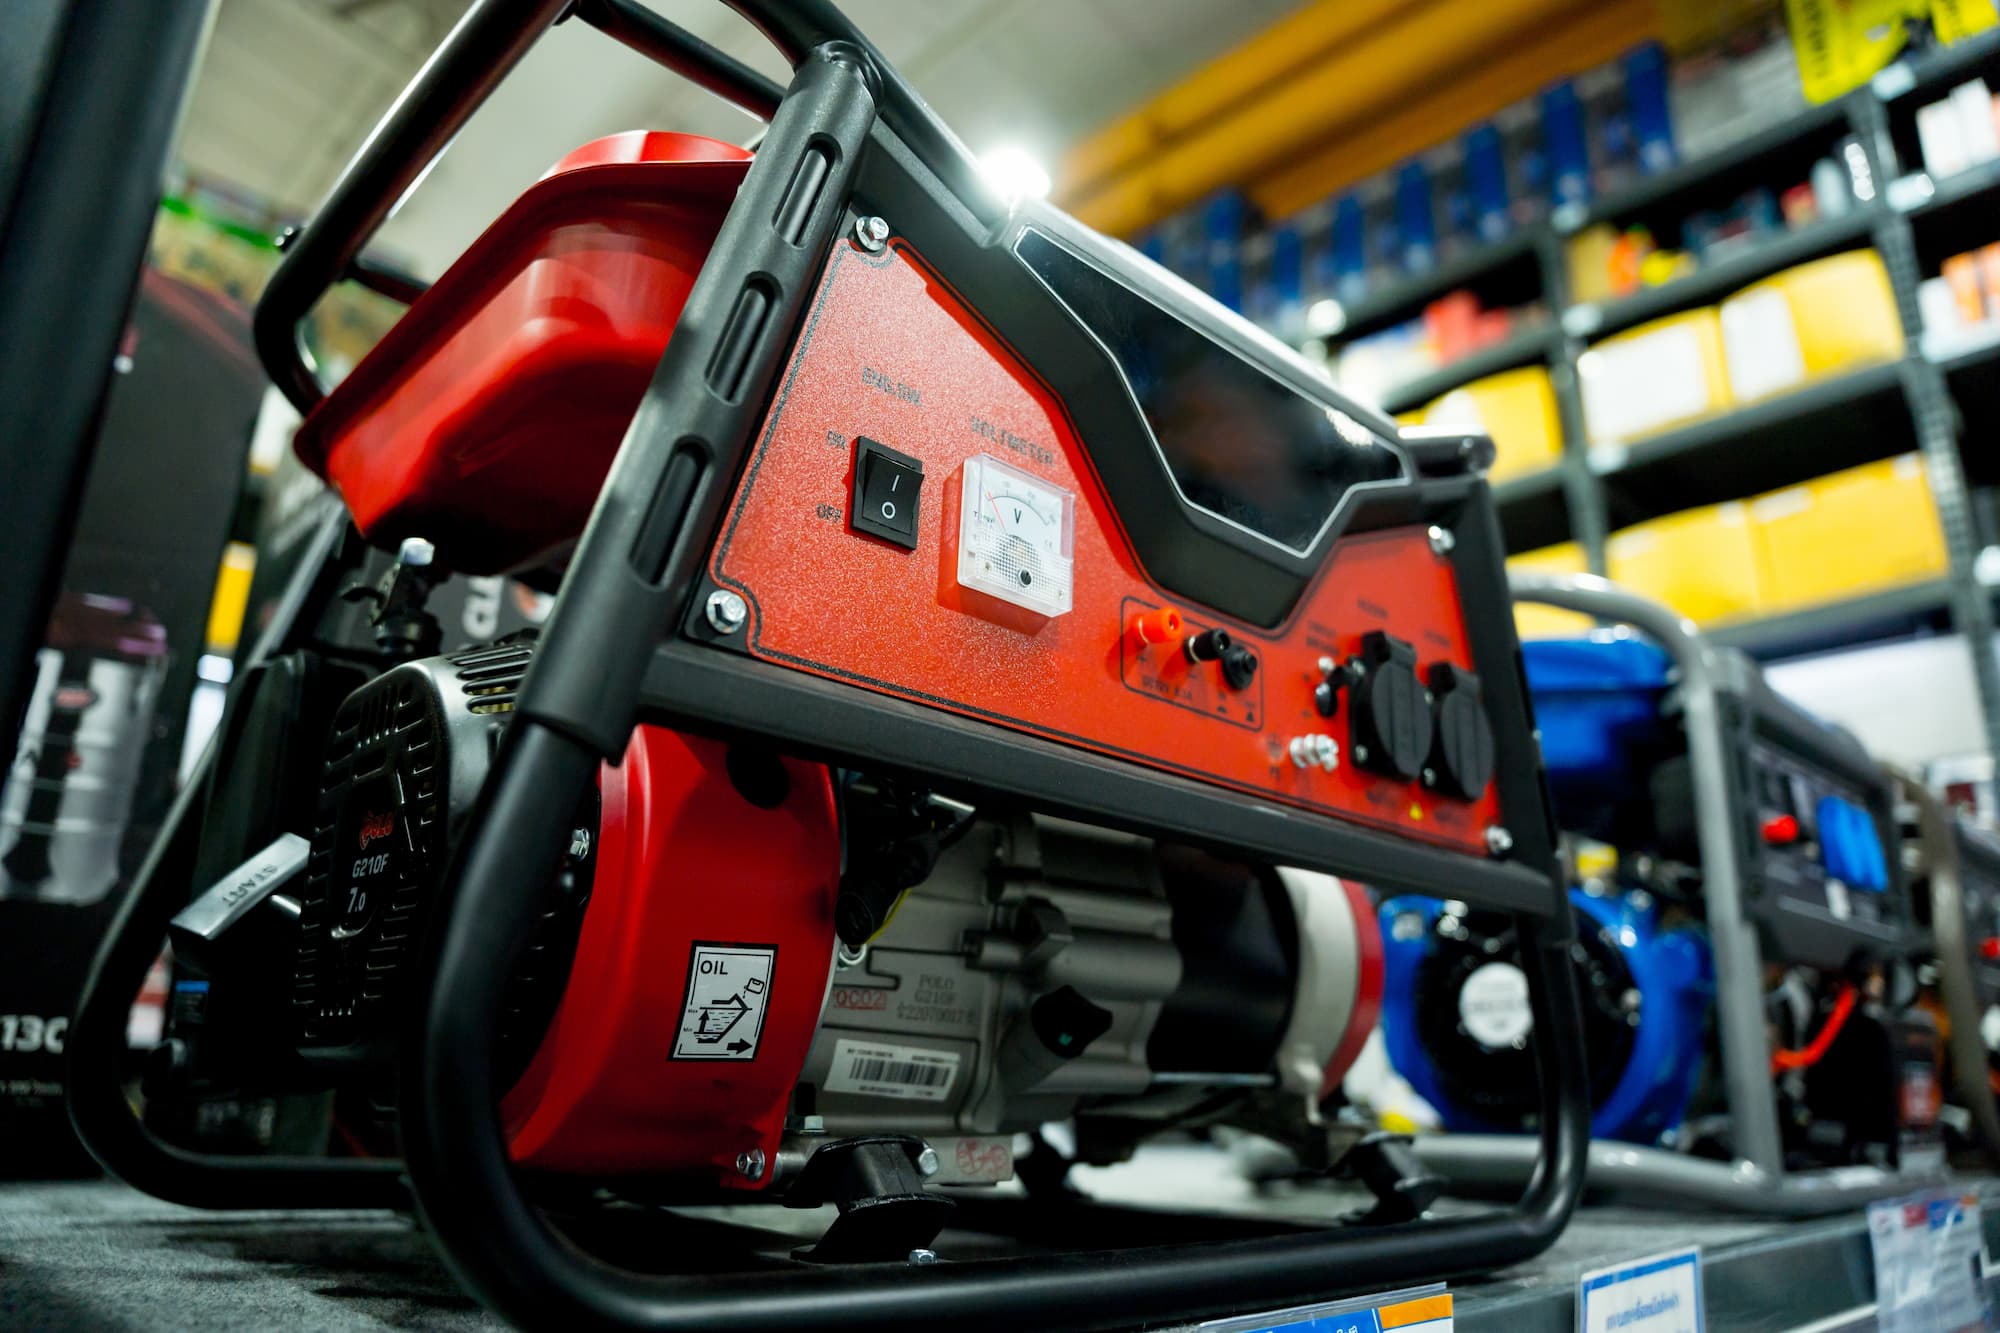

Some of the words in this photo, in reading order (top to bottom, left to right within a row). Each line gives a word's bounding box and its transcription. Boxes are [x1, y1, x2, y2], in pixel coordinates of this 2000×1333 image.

[971, 415, 1054, 466] VOLTMETER
[816, 503, 842, 523] OFF
[1013, 507, 1022, 524] V
[351, 852, 391, 879] G210F
[222, 863, 278, 908] START
[346, 886, 367, 915] 7.0
[700, 960, 728, 975] OIL
